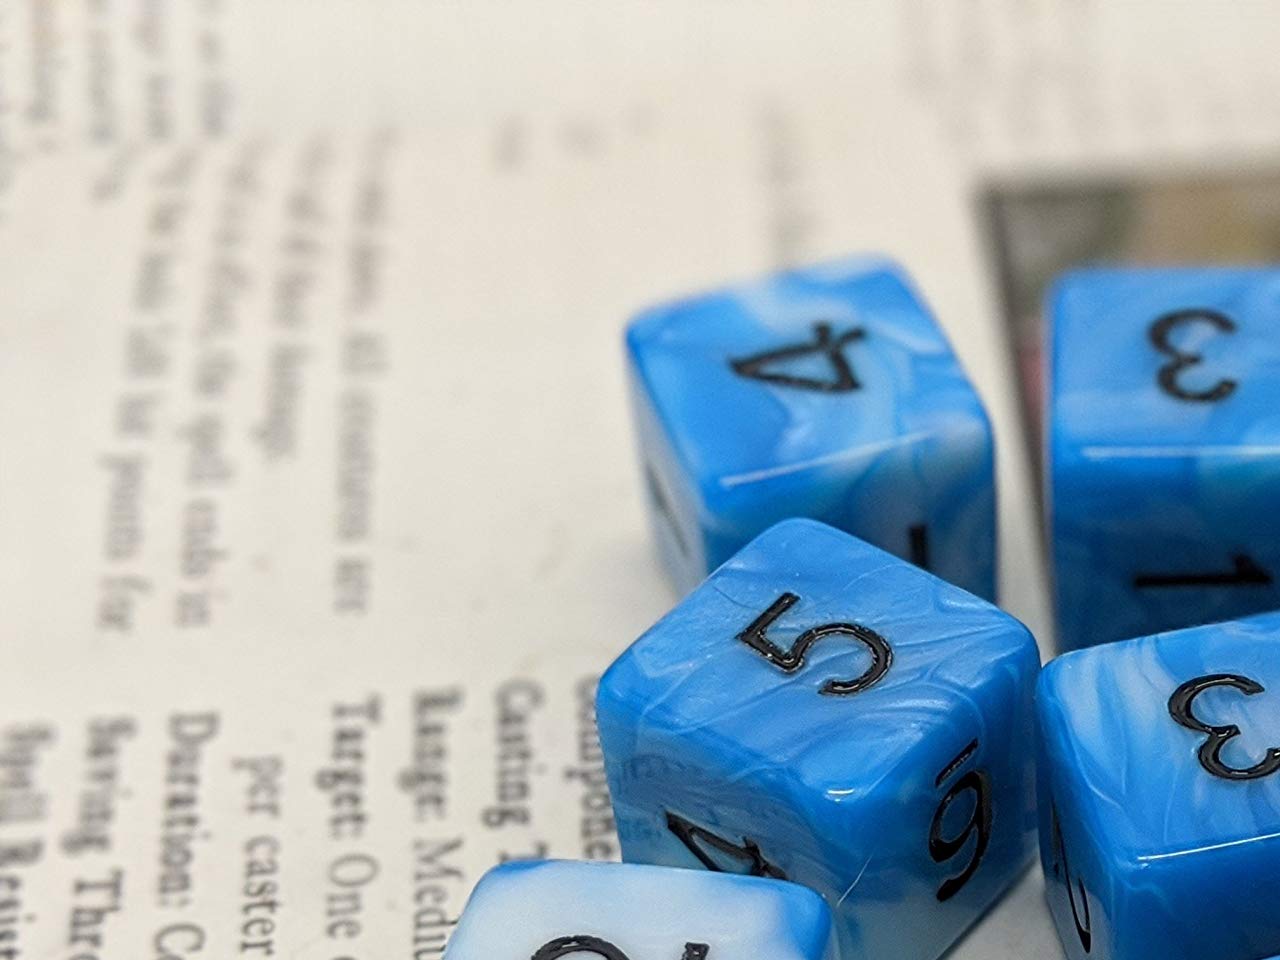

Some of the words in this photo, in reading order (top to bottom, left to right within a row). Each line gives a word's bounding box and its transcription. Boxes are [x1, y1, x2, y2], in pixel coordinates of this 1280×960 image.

[727, 321, 867, 393] 4
[1146, 308, 1240, 404] 3
[1133, 552, 1274, 590] 1
[735, 593, 894, 696] 5
[240, 834, 282, 956] caster
[327, 853, 381, 938] One
